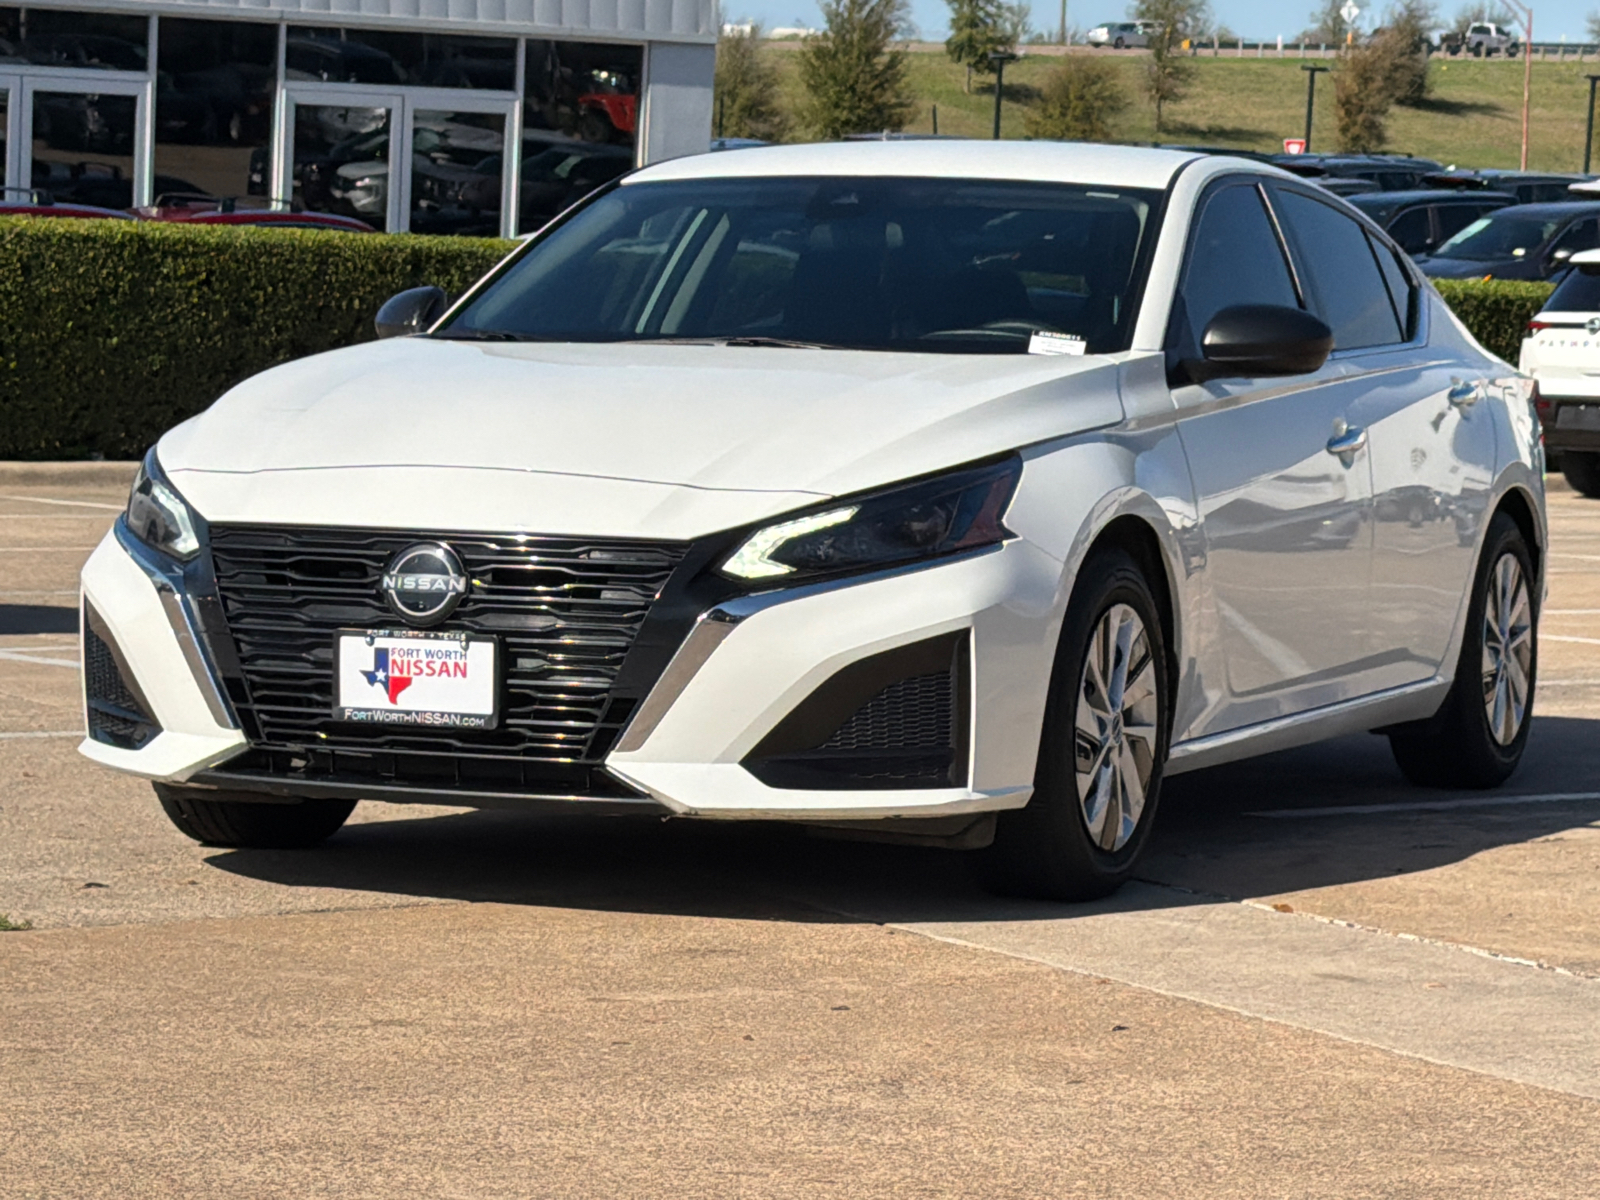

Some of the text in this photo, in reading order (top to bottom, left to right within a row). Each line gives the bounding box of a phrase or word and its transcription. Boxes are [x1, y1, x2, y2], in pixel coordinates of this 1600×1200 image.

[383, 576, 467, 592] NISSAN
[366, 629, 466, 641] FORT WORTH TEXAS
[390, 647, 468, 660] FORT WORTH
[391, 659, 467, 678] NISSAN
